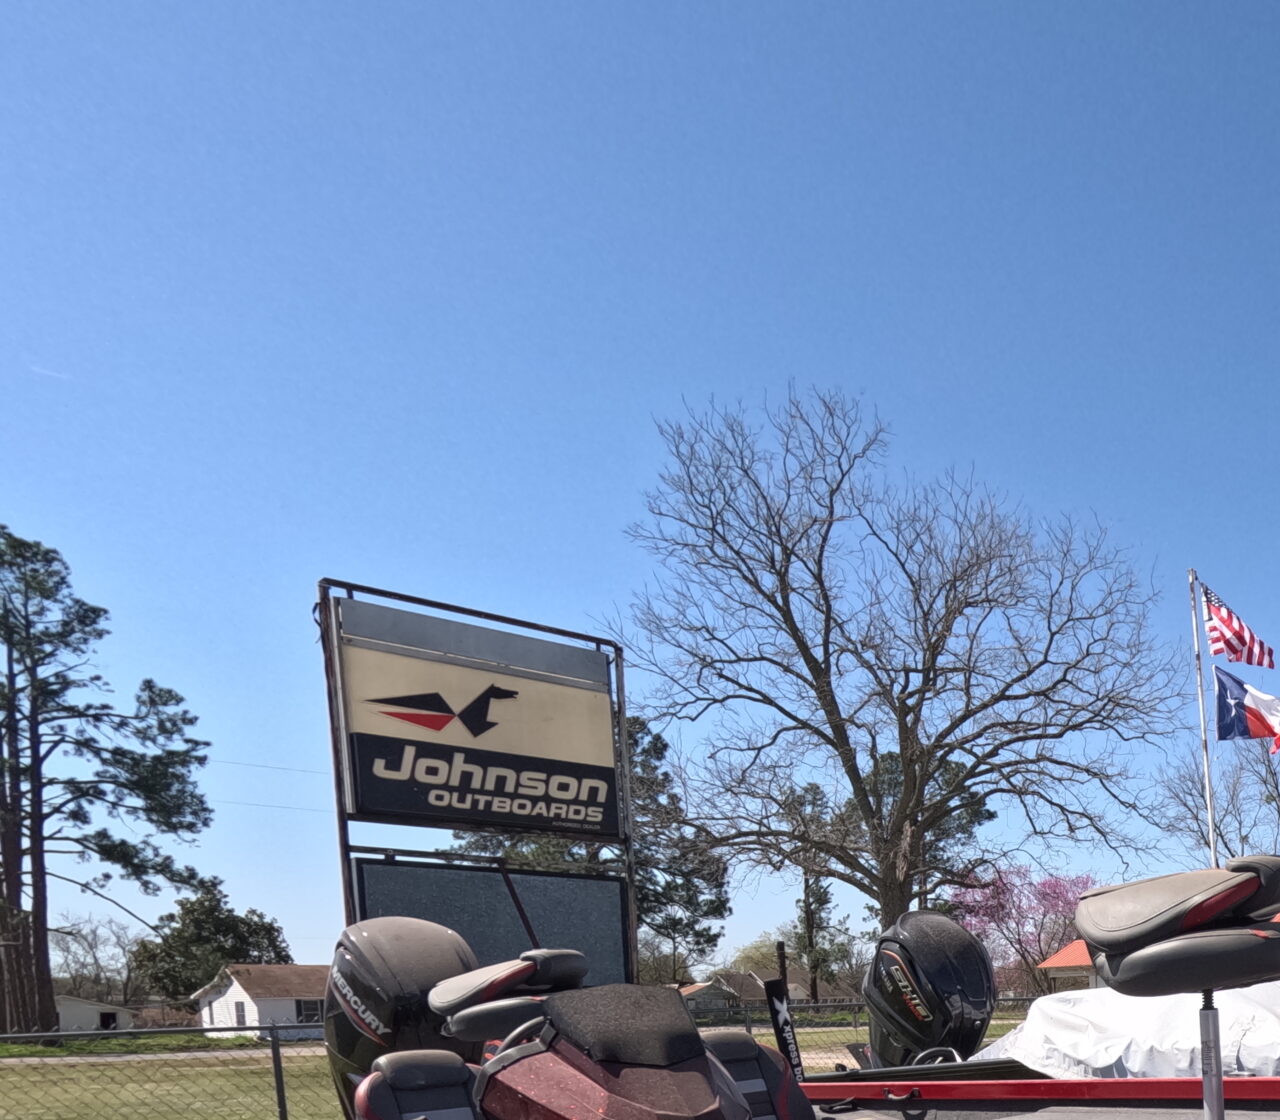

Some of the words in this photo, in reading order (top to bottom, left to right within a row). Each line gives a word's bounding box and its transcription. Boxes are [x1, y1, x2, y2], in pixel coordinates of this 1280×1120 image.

[372, 745, 608, 803] Johnson
[427, 789, 604, 822] OUTBOARDS
[332, 965, 392, 1035] MERCURY
